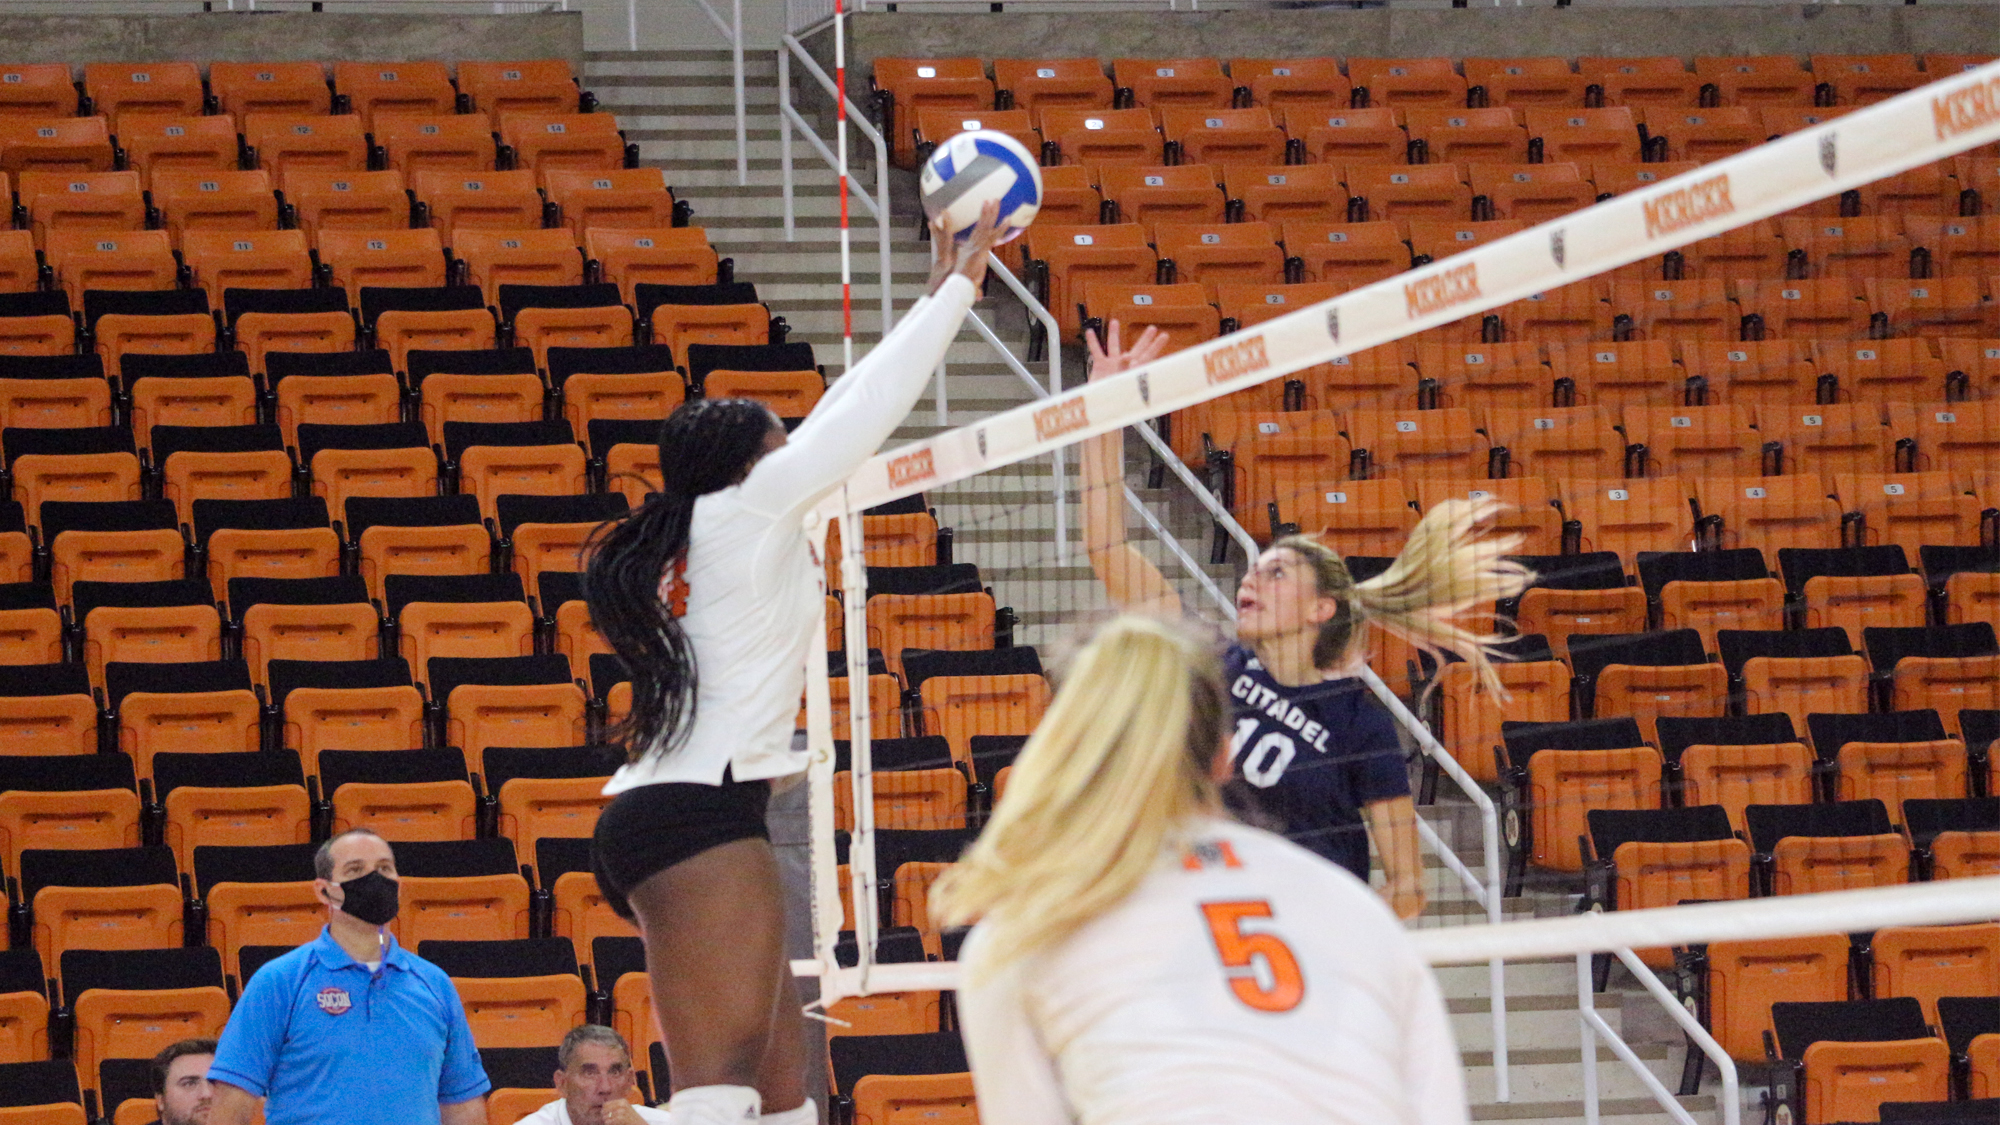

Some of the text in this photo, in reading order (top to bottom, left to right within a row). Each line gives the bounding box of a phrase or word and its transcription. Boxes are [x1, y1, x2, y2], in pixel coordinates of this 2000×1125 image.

[260, 73, 271, 81] 12
[297, 126, 308, 134] 12
[1642, 173, 1735, 239] MERCER
[639, 239, 650, 247] 14
[1405, 262, 1482, 319] MERCER
[1203, 334, 1270, 386] MERCER
[1231, 674, 1331, 754] CITADEL
[1227, 717, 1297, 789] 10
[1198, 898, 1306, 1013] 5
[316, 991, 352, 1009] SOCON
